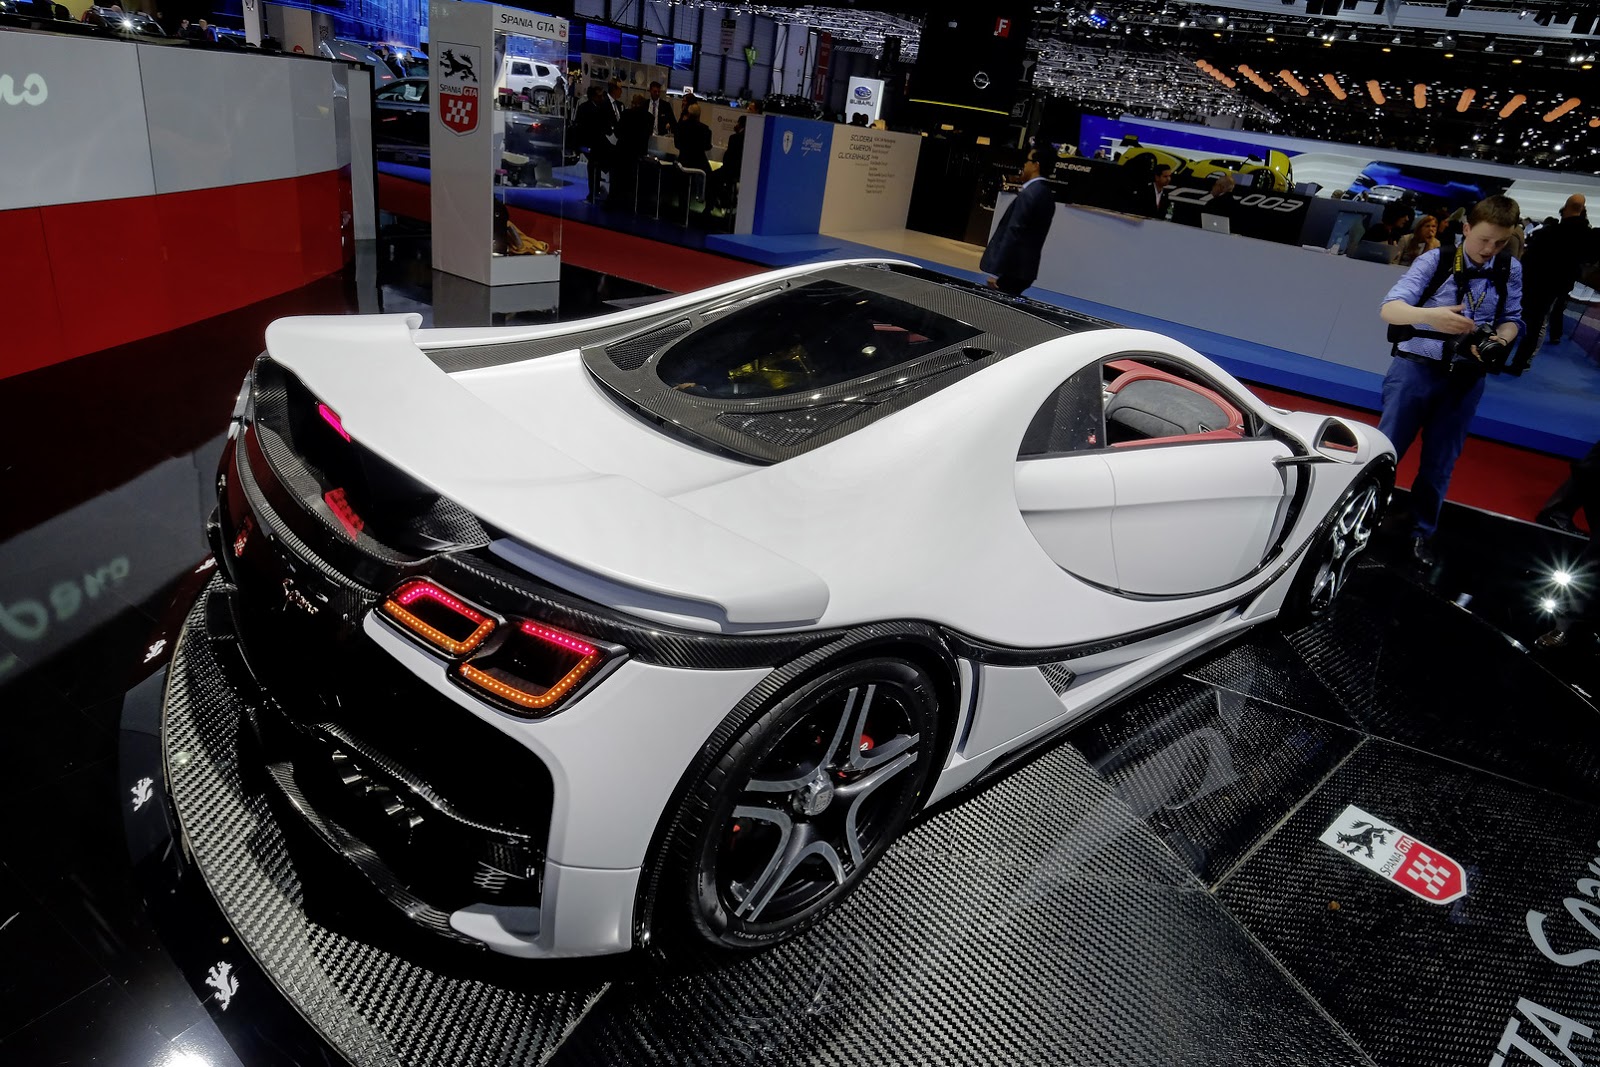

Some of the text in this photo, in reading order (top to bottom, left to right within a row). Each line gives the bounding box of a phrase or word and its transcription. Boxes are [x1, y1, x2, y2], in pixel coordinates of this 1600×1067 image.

[500, 13, 555, 33] SPANIA GTA
[997, 18, 1009, 33] F
[439, 83, 478, 98] SPANIA GTA
[849, 143, 872, 152] CAMERON
[837, 151, 871, 162] GLICKENHAUS
[1379, 837, 1415, 877] SPANIA GTA
[1488, 996, 1594, 1067] TA
